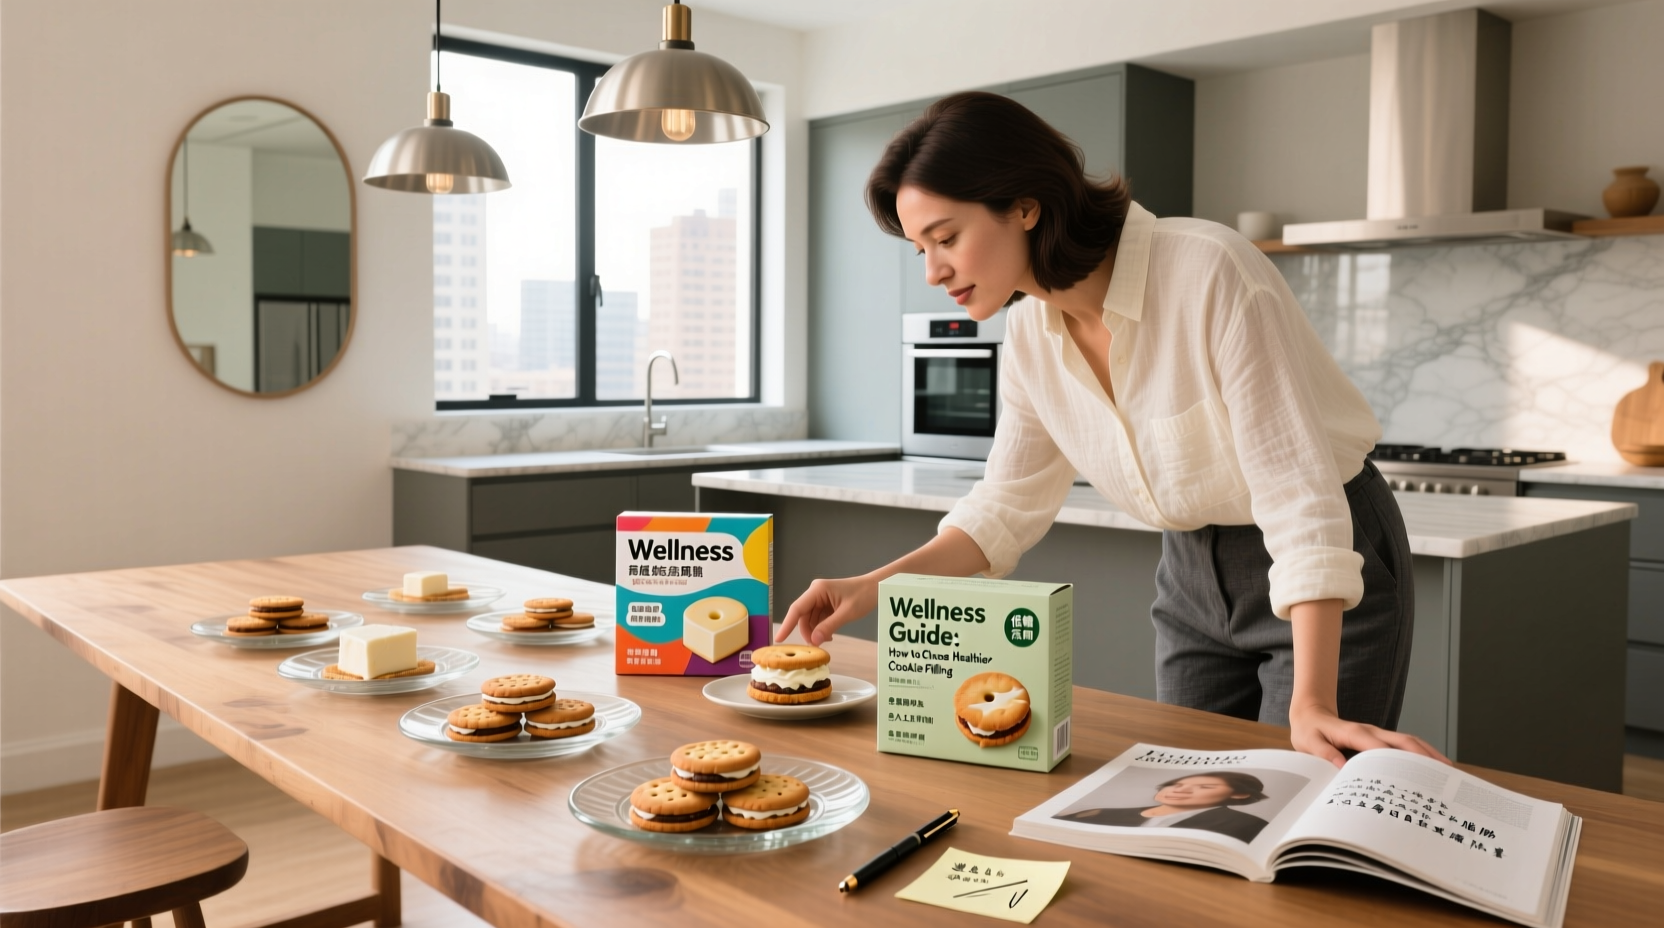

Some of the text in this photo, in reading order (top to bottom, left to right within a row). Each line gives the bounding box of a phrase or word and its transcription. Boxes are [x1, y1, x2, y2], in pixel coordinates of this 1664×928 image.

[628, 538, 734, 561] Wellness
[889, 596, 986, 623] Wellness
[889, 621, 960, 647] Guide:
[888, 646, 909, 658] How
